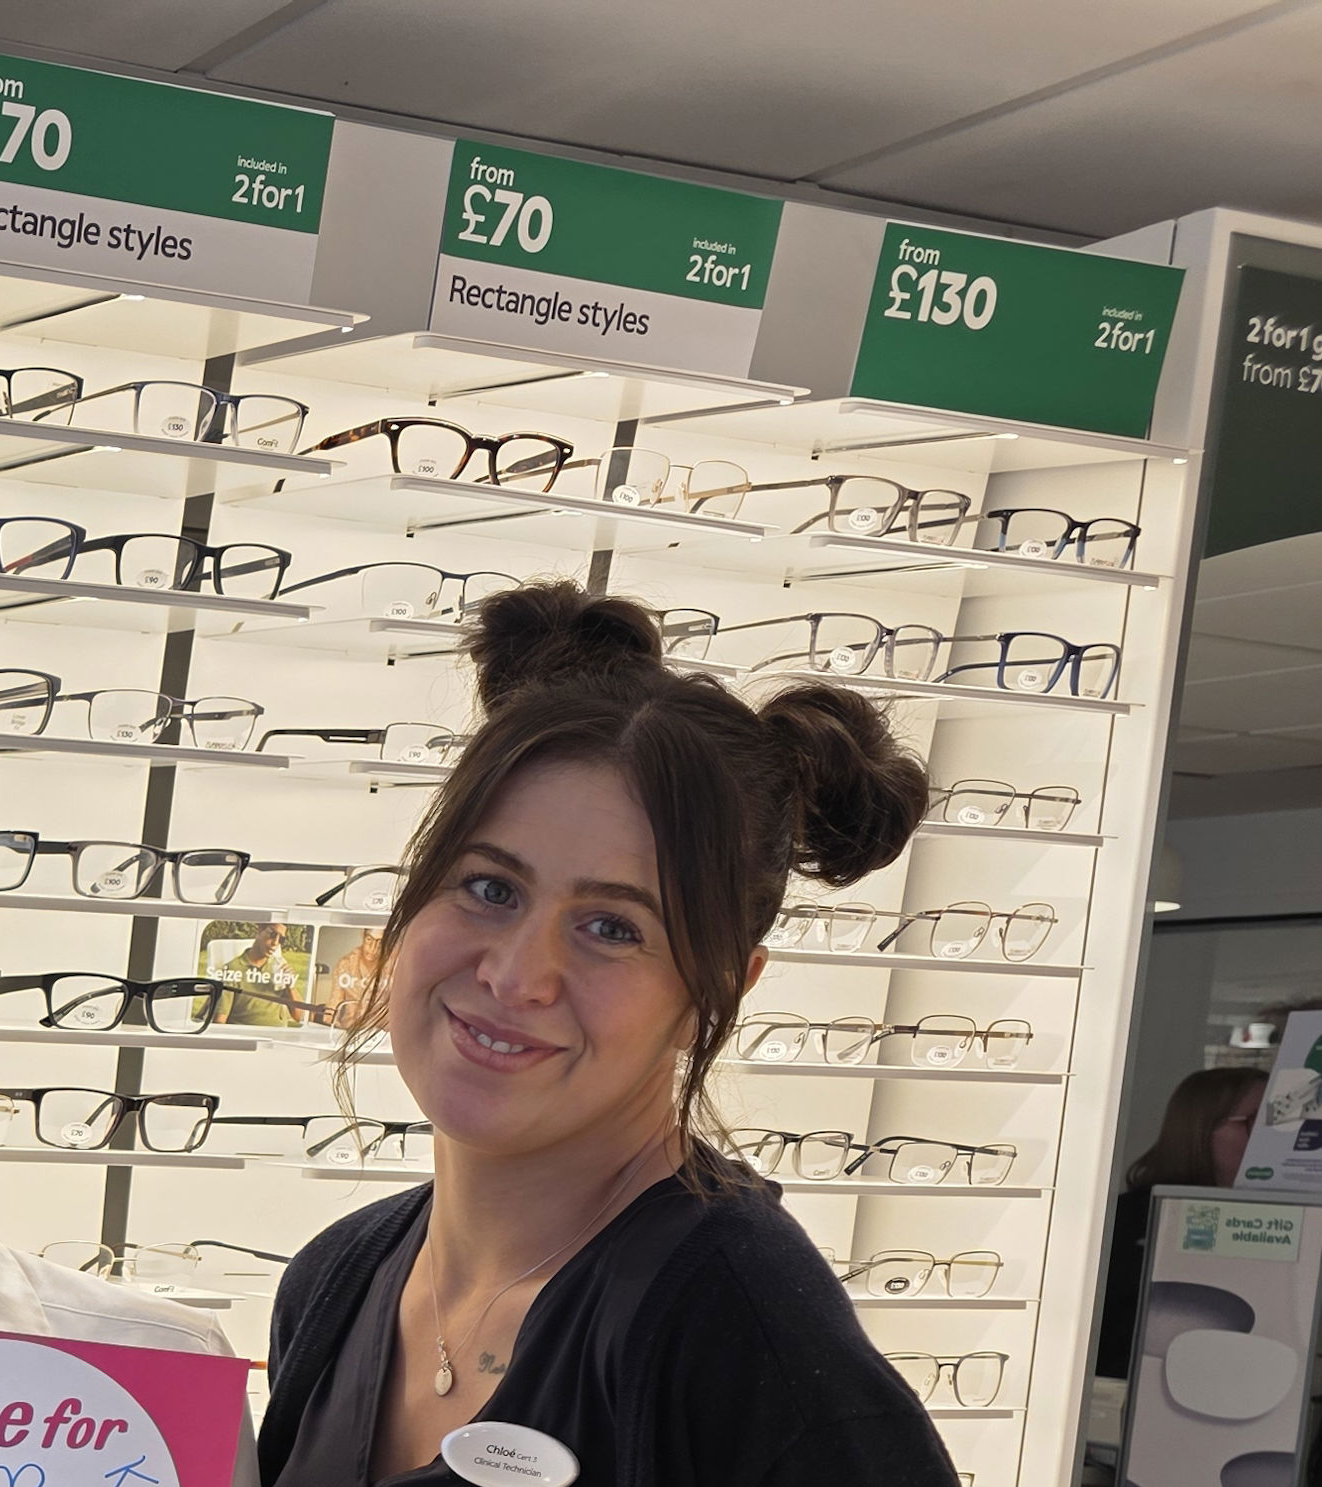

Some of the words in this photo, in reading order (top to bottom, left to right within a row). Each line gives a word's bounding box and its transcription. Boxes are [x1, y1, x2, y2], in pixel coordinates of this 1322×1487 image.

[237, 155, 276, 173] included
[277, 162, 288, 175] in
[469, 156, 515, 186] from
[231, 174, 306, 213] 2for1
[458, 184, 554, 254] £70
[107, 224, 193, 261] styles
[692, 237, 727, 254] included
[728, 243, 737, 255] in
[898, 238, 941, 266] from
[685, 255, 752, 291] 2for1
[449, 275, 572, 326] Rectangle
[577, 303, 650, 336] styles
[884, 264, 998, 330] £130
[1102, 306, 1133, 321] included
[1134, 311, 1143, 321] in
[1094, 322, 1155, 354] 2for1
[1243, 353, 1292, 389] from
[1297, 366, 1322, 394] £7
[207, 965, 242, 983] Seize
[245, 966, 271, 984] the
[273, 968, 299, 988] day
[41, 1397, 128, 1451] for
[486, 1444, 516, 1458] Chloé
[474, 1457, 501, 1469] Clinical
[502, 1463, 542, 1478] Technician
